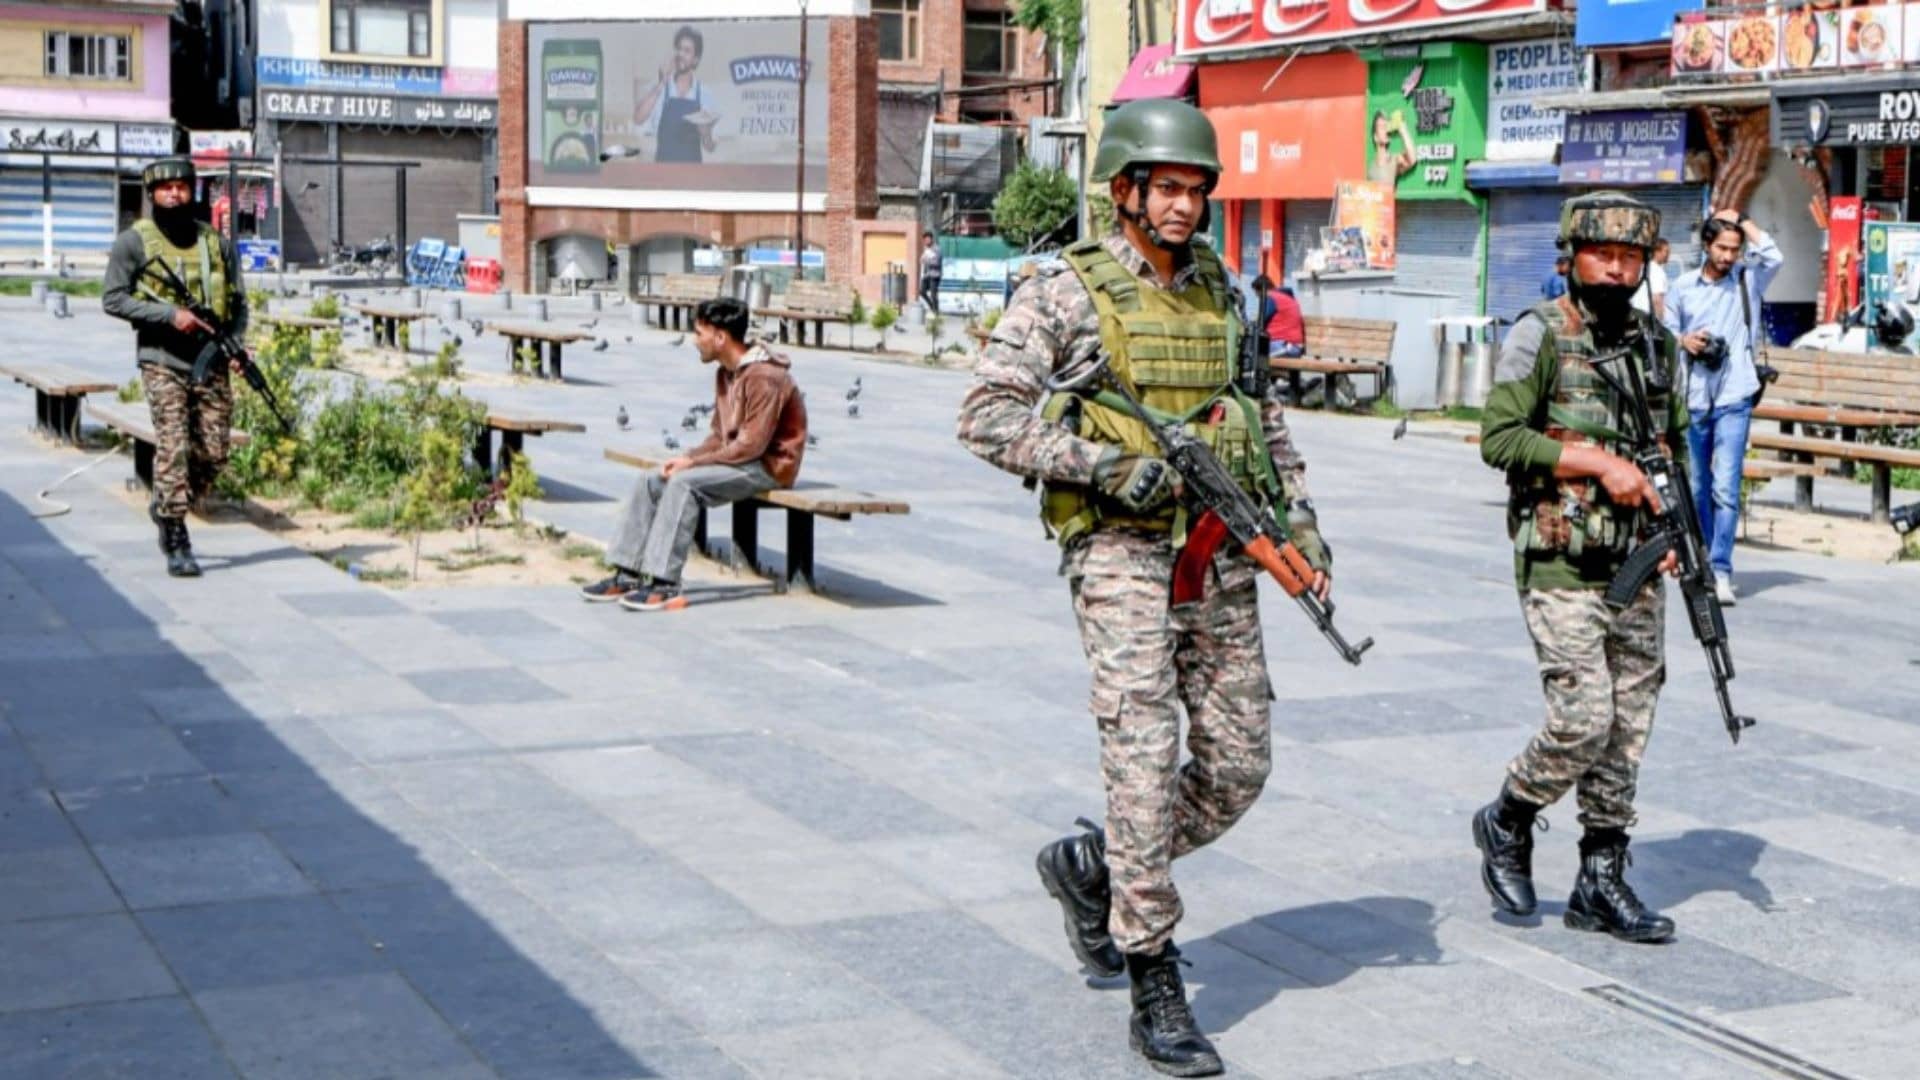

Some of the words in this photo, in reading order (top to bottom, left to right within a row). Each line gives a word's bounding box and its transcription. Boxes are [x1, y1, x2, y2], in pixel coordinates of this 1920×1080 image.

[407, 66, 438, 83] ALI
[267, 93, 334, 115] CRAFT
[342, 97, 392, 117] HIVE
[740, 118, 798, 136] FINEST
[1584, 121, 1615, 142] KING
[1620, 119, 1680, 141] MOBILES
[1848, 122, 1885, 141] PURE
[1889, 121, 1920, 140] VEG
